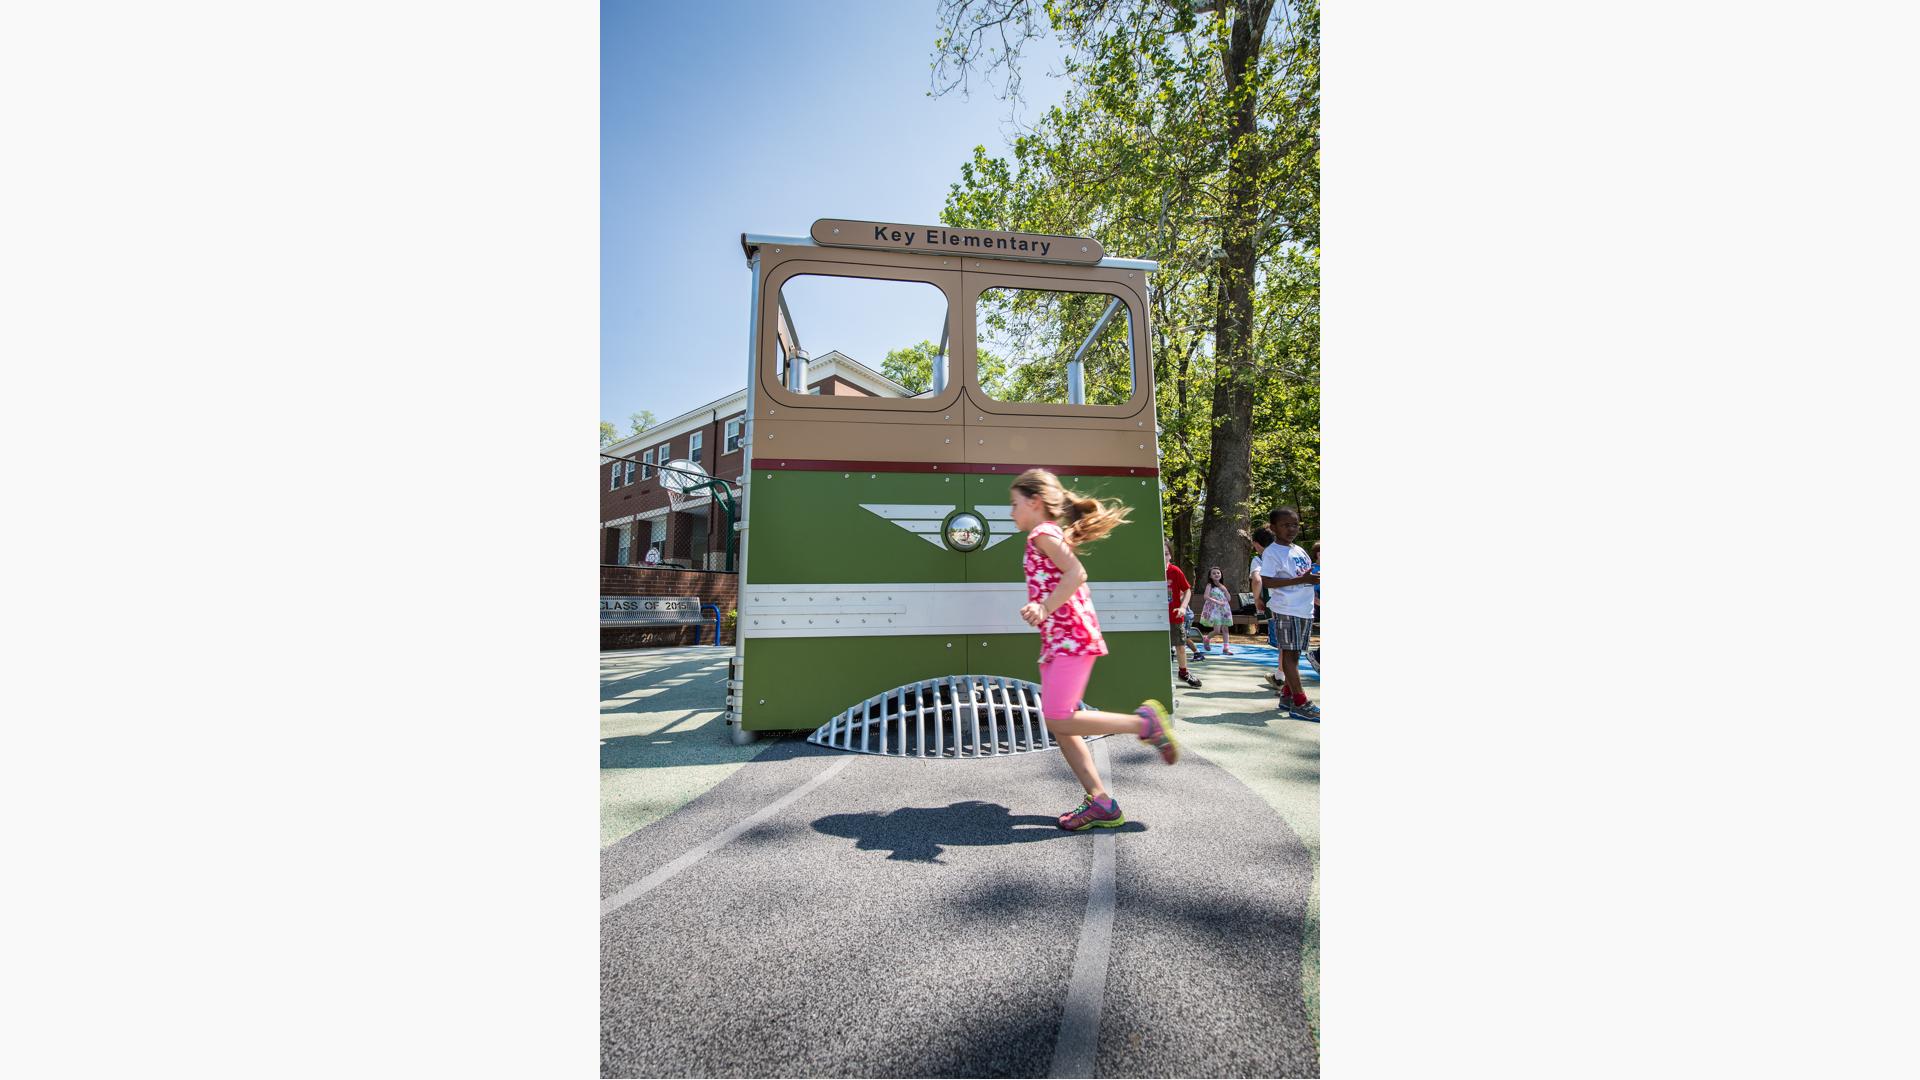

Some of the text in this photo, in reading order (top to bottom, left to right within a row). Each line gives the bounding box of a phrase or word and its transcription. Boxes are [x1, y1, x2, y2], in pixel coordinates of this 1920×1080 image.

[874, 226, 1051, 256] Key Elementary
[600, 601, 687, 611] CLASS OF 2015
